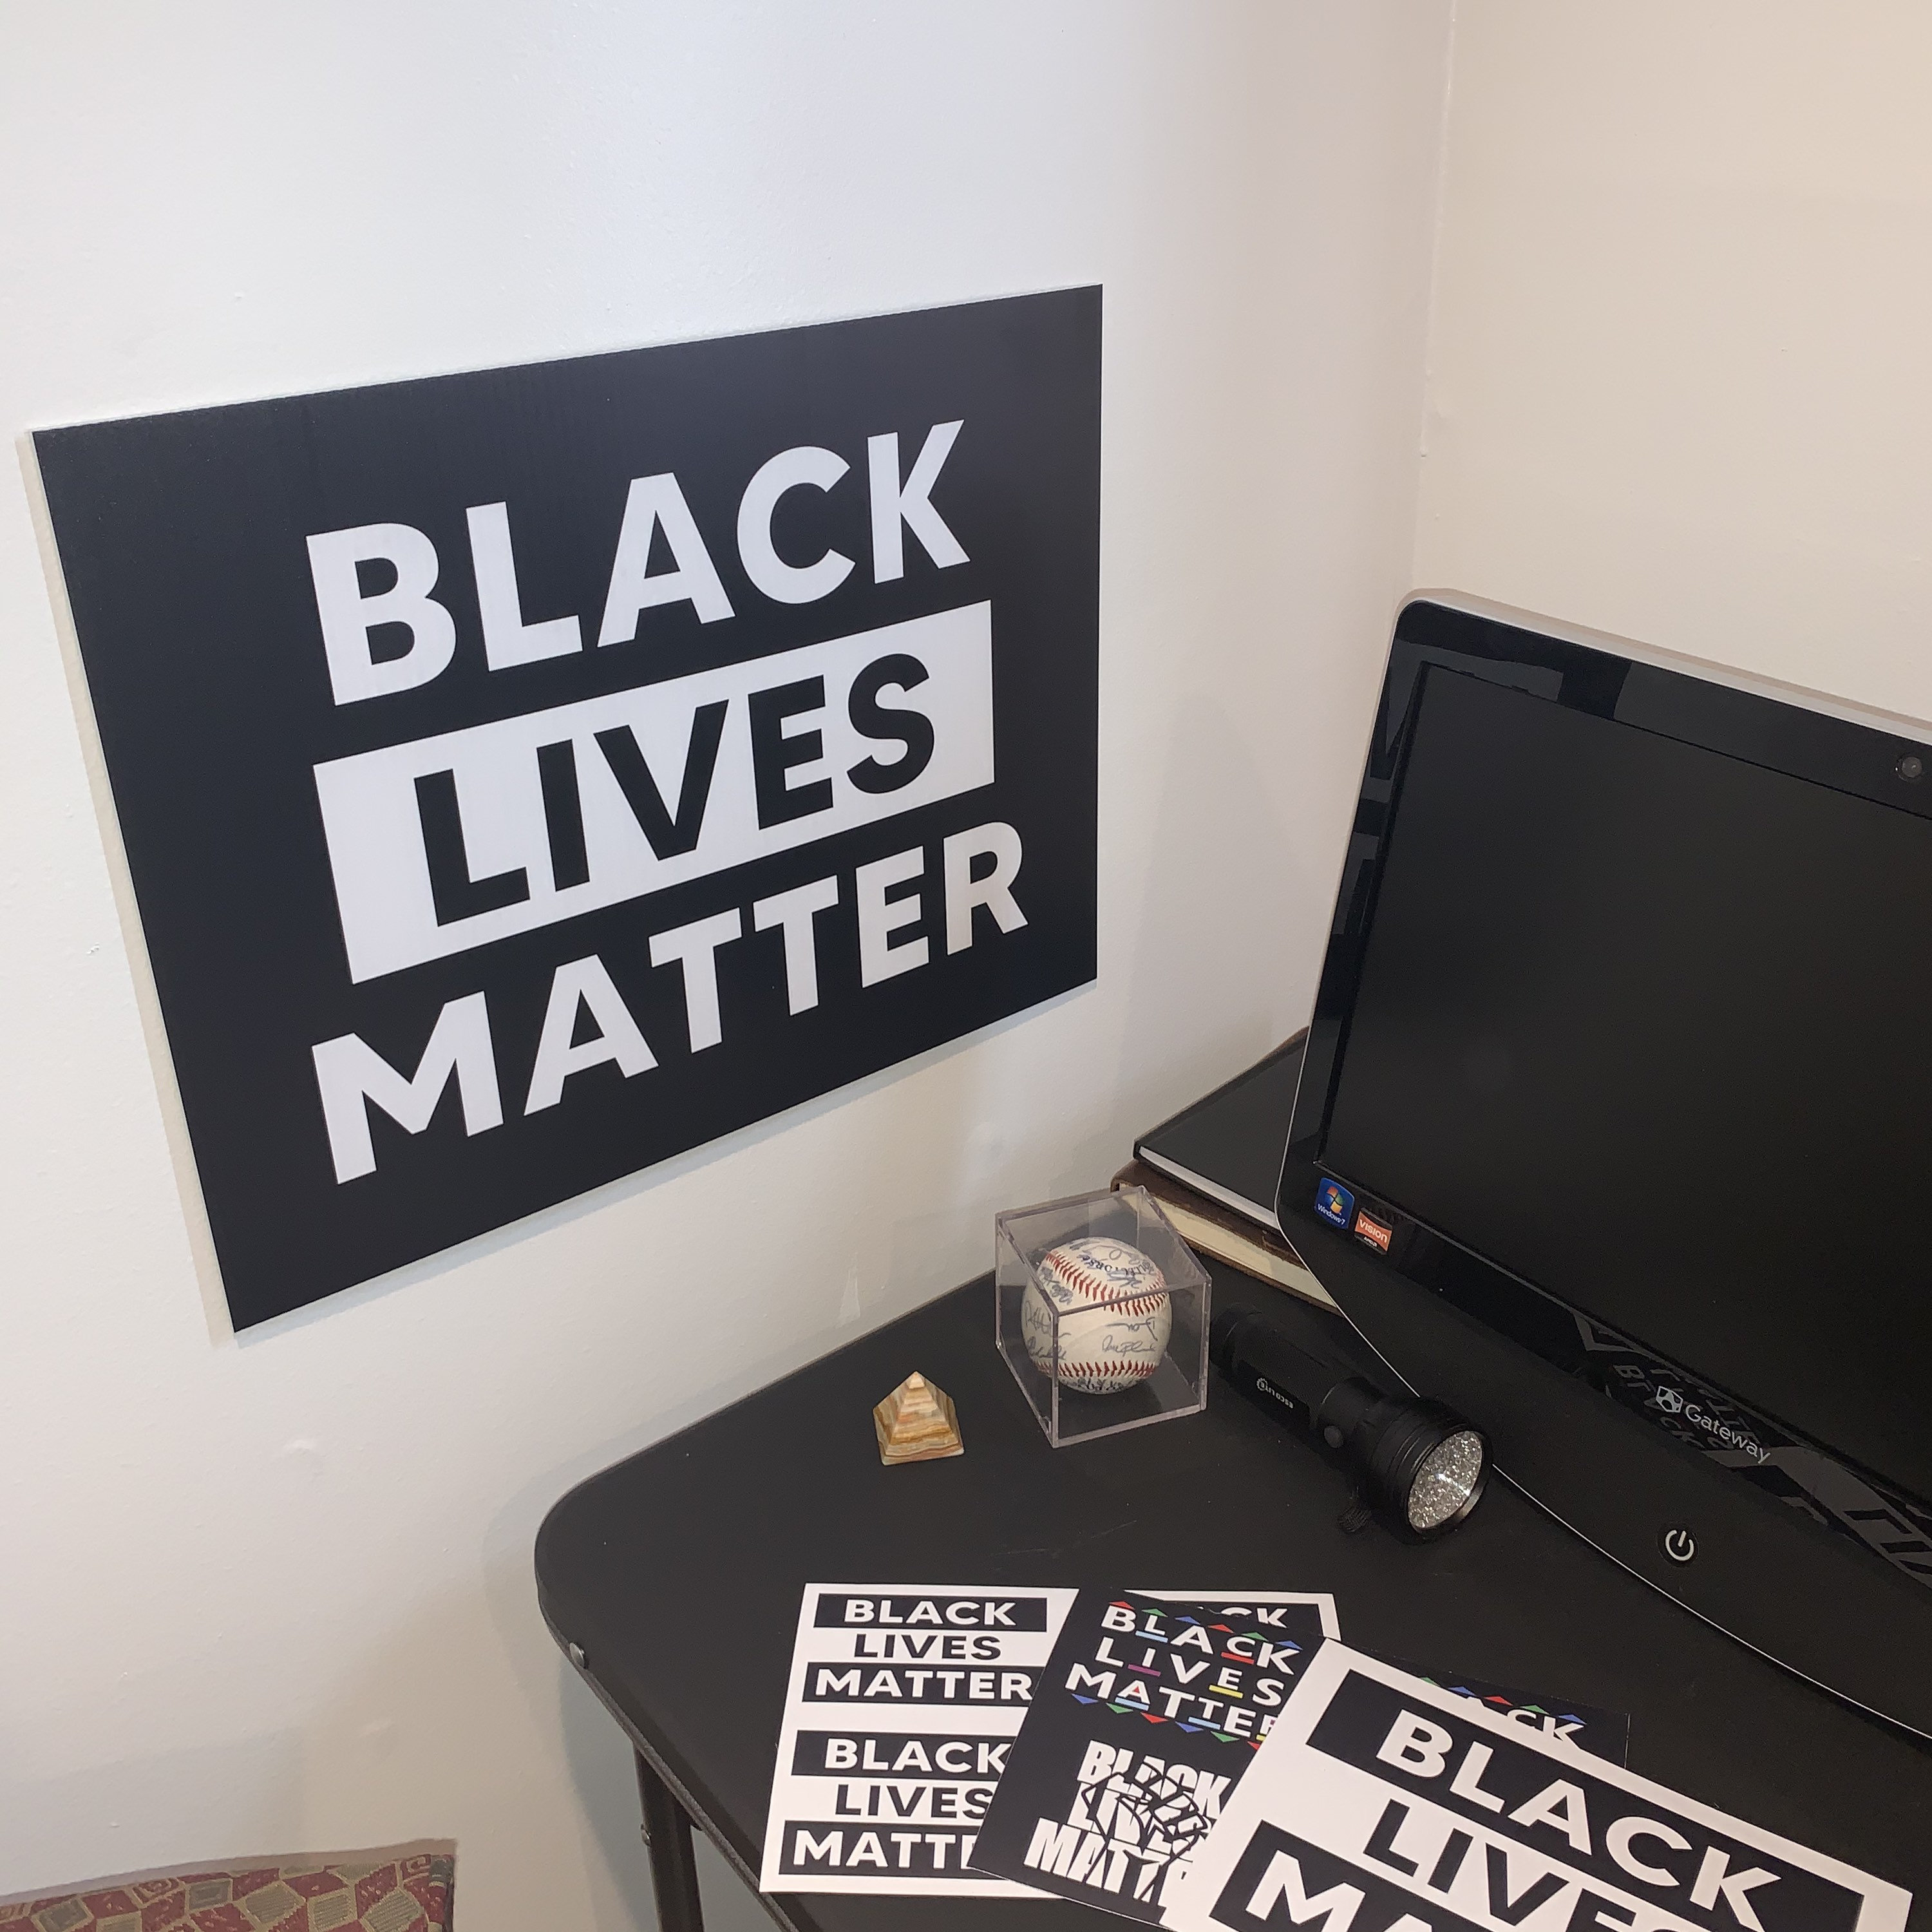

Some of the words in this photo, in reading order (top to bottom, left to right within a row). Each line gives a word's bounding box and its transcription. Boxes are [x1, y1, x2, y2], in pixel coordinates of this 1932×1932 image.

[306, 419, 971, 706] BLACK
[414, 653, 935, 927] LIVES
[311, 821, 1028, 1185] MATTER
[1318, 1204, 1342, 1223] Windows
[1685, 1404, 1771, 1464] Gateway
[844, 1598, 1017, 1626] BLACK
[1101, 1604, 1300, 1675] BLACK
[853, 1633, 1001, 1660] LIVES
[1095, 1636, 1285, 1707] LIVES
[814, 1668, 1033, 1701] MATTER
[824, 1738, 1012, 1774] BLACK
[1077, 1739, 1232, 1820] BLACK
[835, 1783, 994, 1820] LIVES
[1376, 1709, 1782, 1932] BLACK
